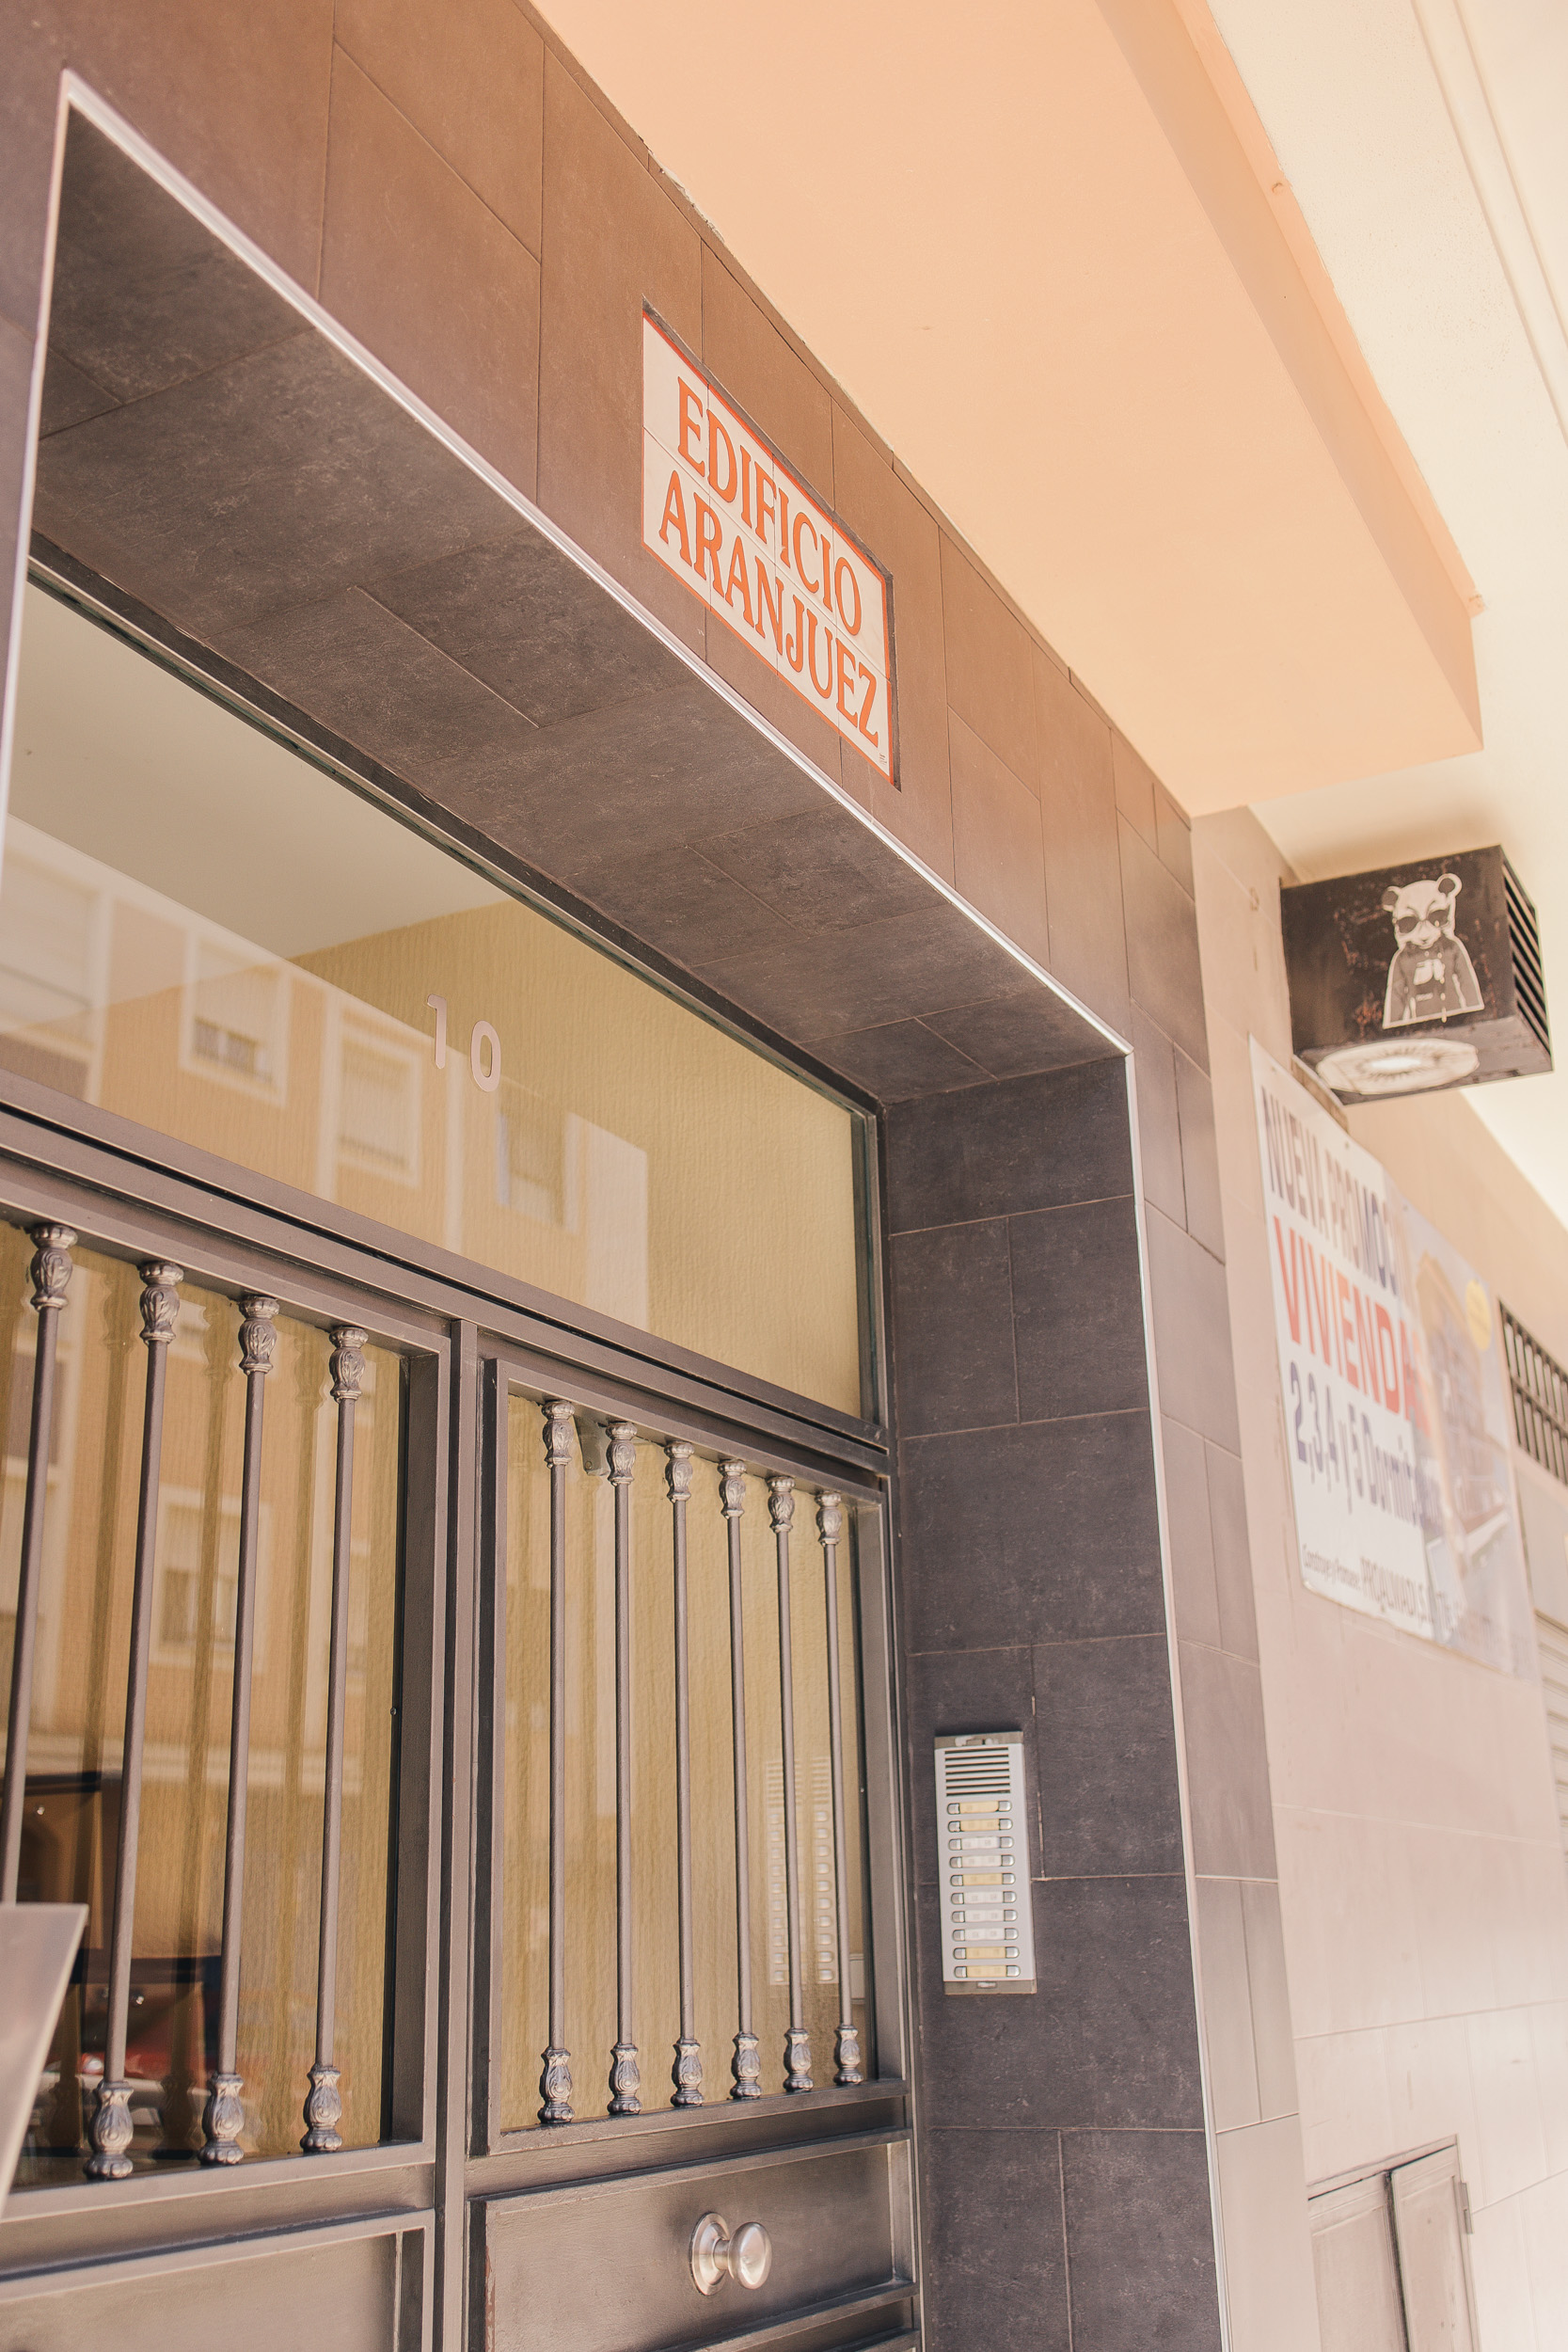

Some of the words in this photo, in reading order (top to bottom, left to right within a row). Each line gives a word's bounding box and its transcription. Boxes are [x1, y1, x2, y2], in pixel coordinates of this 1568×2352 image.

[676, 375, 862, 636] EDIFICIO
[658, 469, 879, 749] ARANJUEZ
[426, 993, 502, 1093] 10
[1261, 1086, 1330, 1242] NUEVA
[1348, 1401, 1364, 1498] 5
